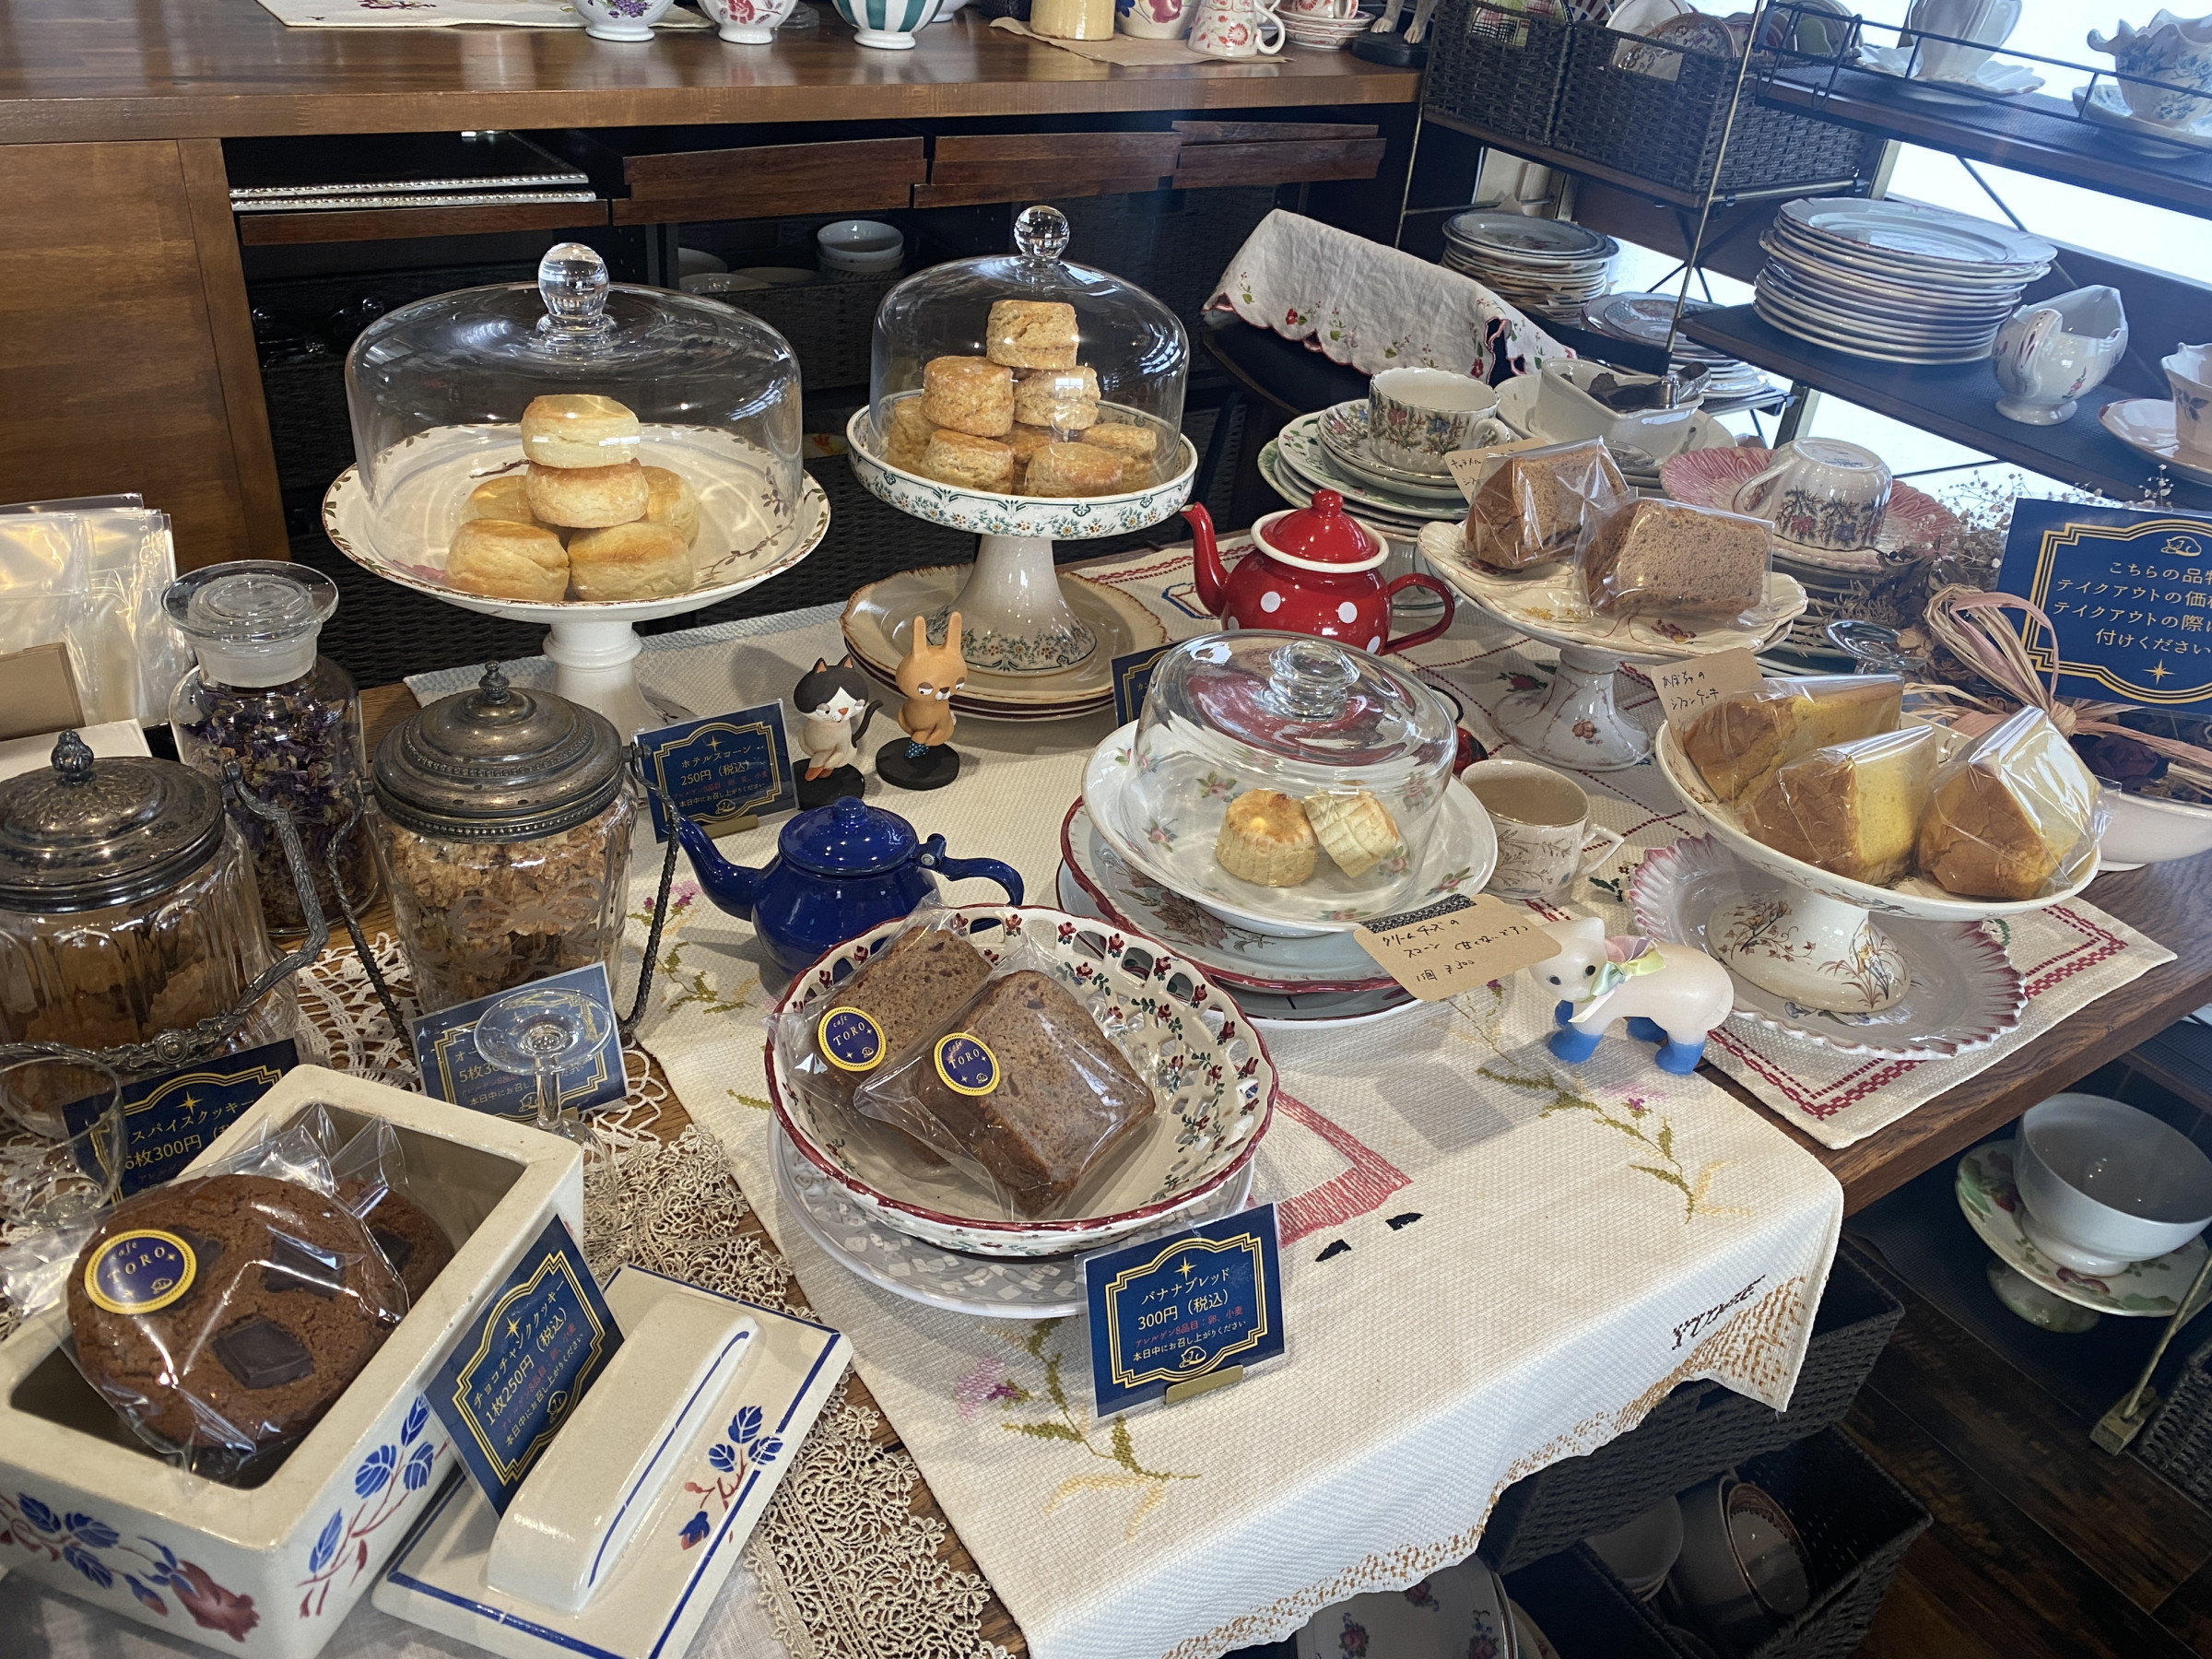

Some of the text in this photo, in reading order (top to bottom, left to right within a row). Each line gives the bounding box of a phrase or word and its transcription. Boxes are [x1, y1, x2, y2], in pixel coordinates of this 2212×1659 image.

[2096, 629, 2211, 654] 付けください
[681, 745, 751, 768] ホテルスコーン
[1403, 943, 1441, 959] スコーン
[833, 1022, 865, 1046] TORO
[948, 1049, 979, 1069] TORO
[131, 1100, 254, 1144] スパイスクッキー
[107, 1246, 165, 1284] TORO
[1142, 1268, 1230, 1305] バナナブレッド
[474, 1280, 564, 1409] チョコチャンククッキー
[1133, 1321, 1246, 1361] 本日中にお召し上がりください
[506, 1334, 584, 1447] 本日中にお召し上がりください
